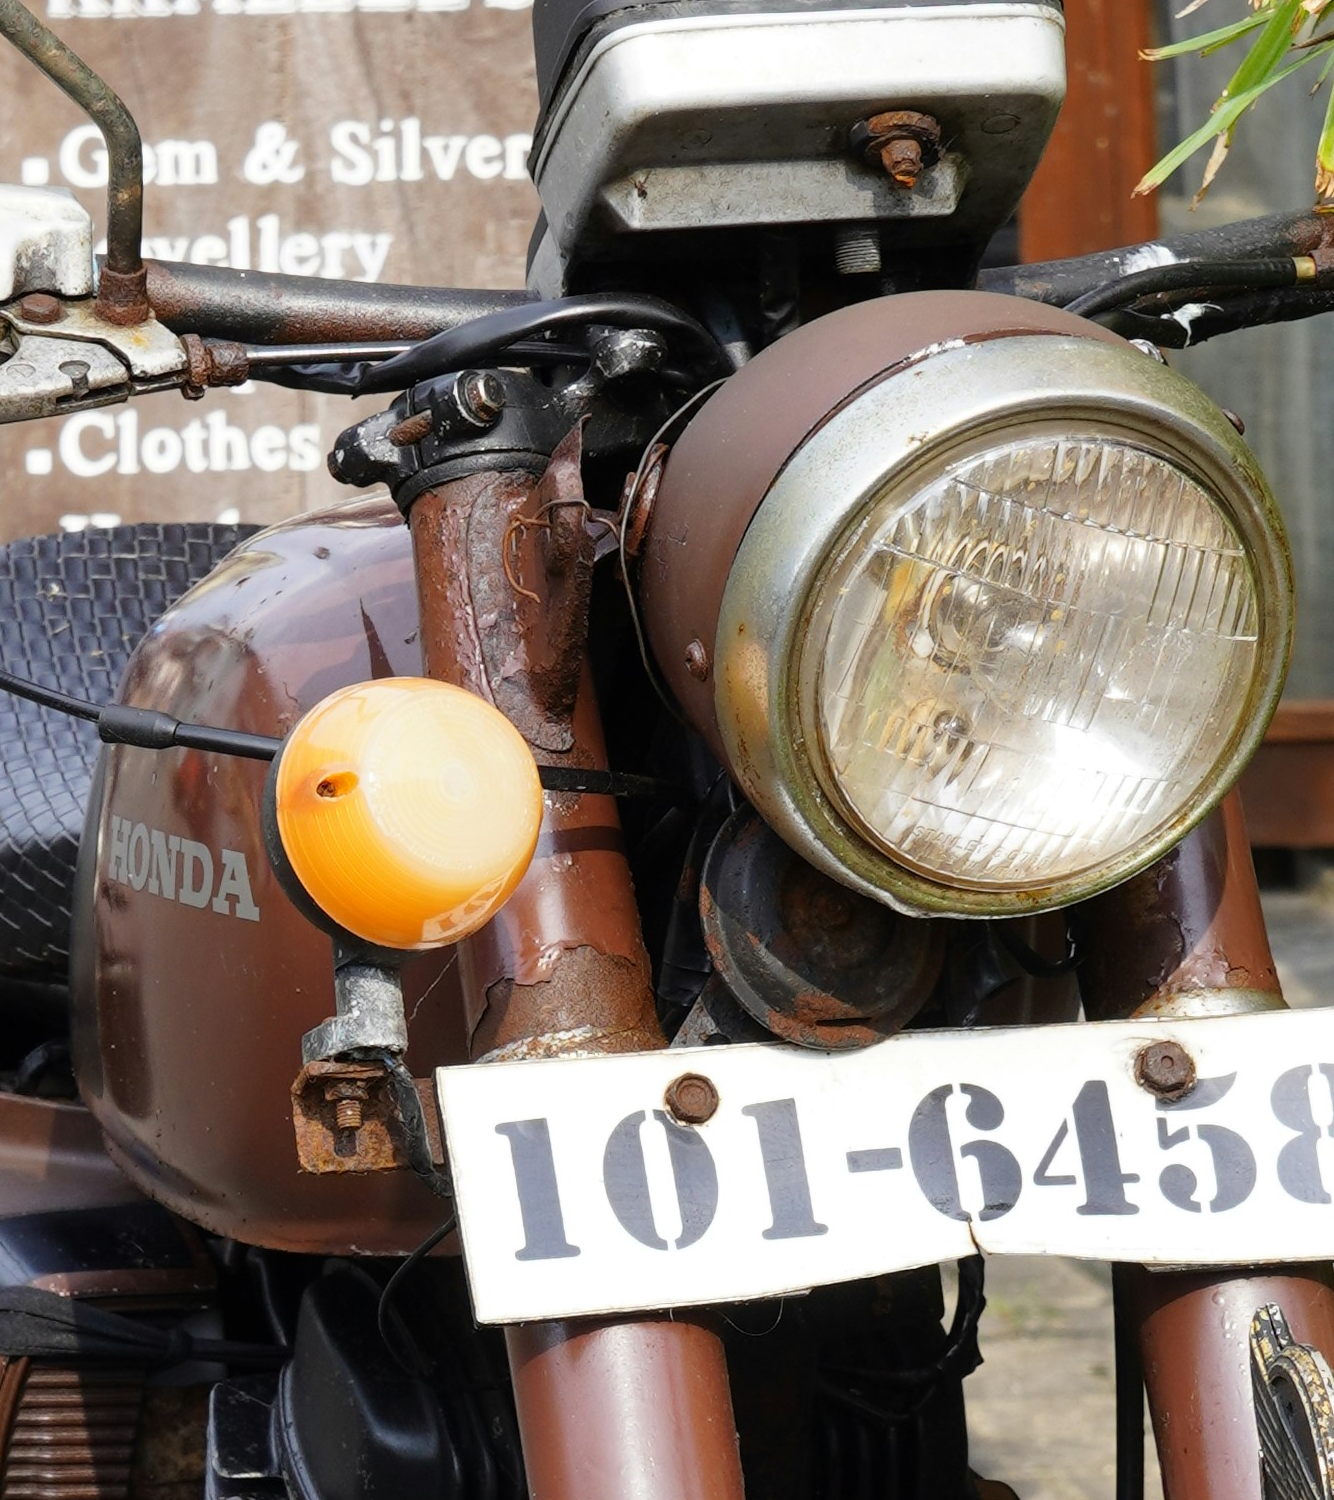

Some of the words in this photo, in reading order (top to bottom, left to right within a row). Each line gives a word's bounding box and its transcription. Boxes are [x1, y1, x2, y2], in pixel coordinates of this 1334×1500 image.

[244, 121, 305, 185] &
[330, 117, 533, 186] Silver
[59, 408, 320, 477] Clothes
[107, 814, 260, 922] HONDA
